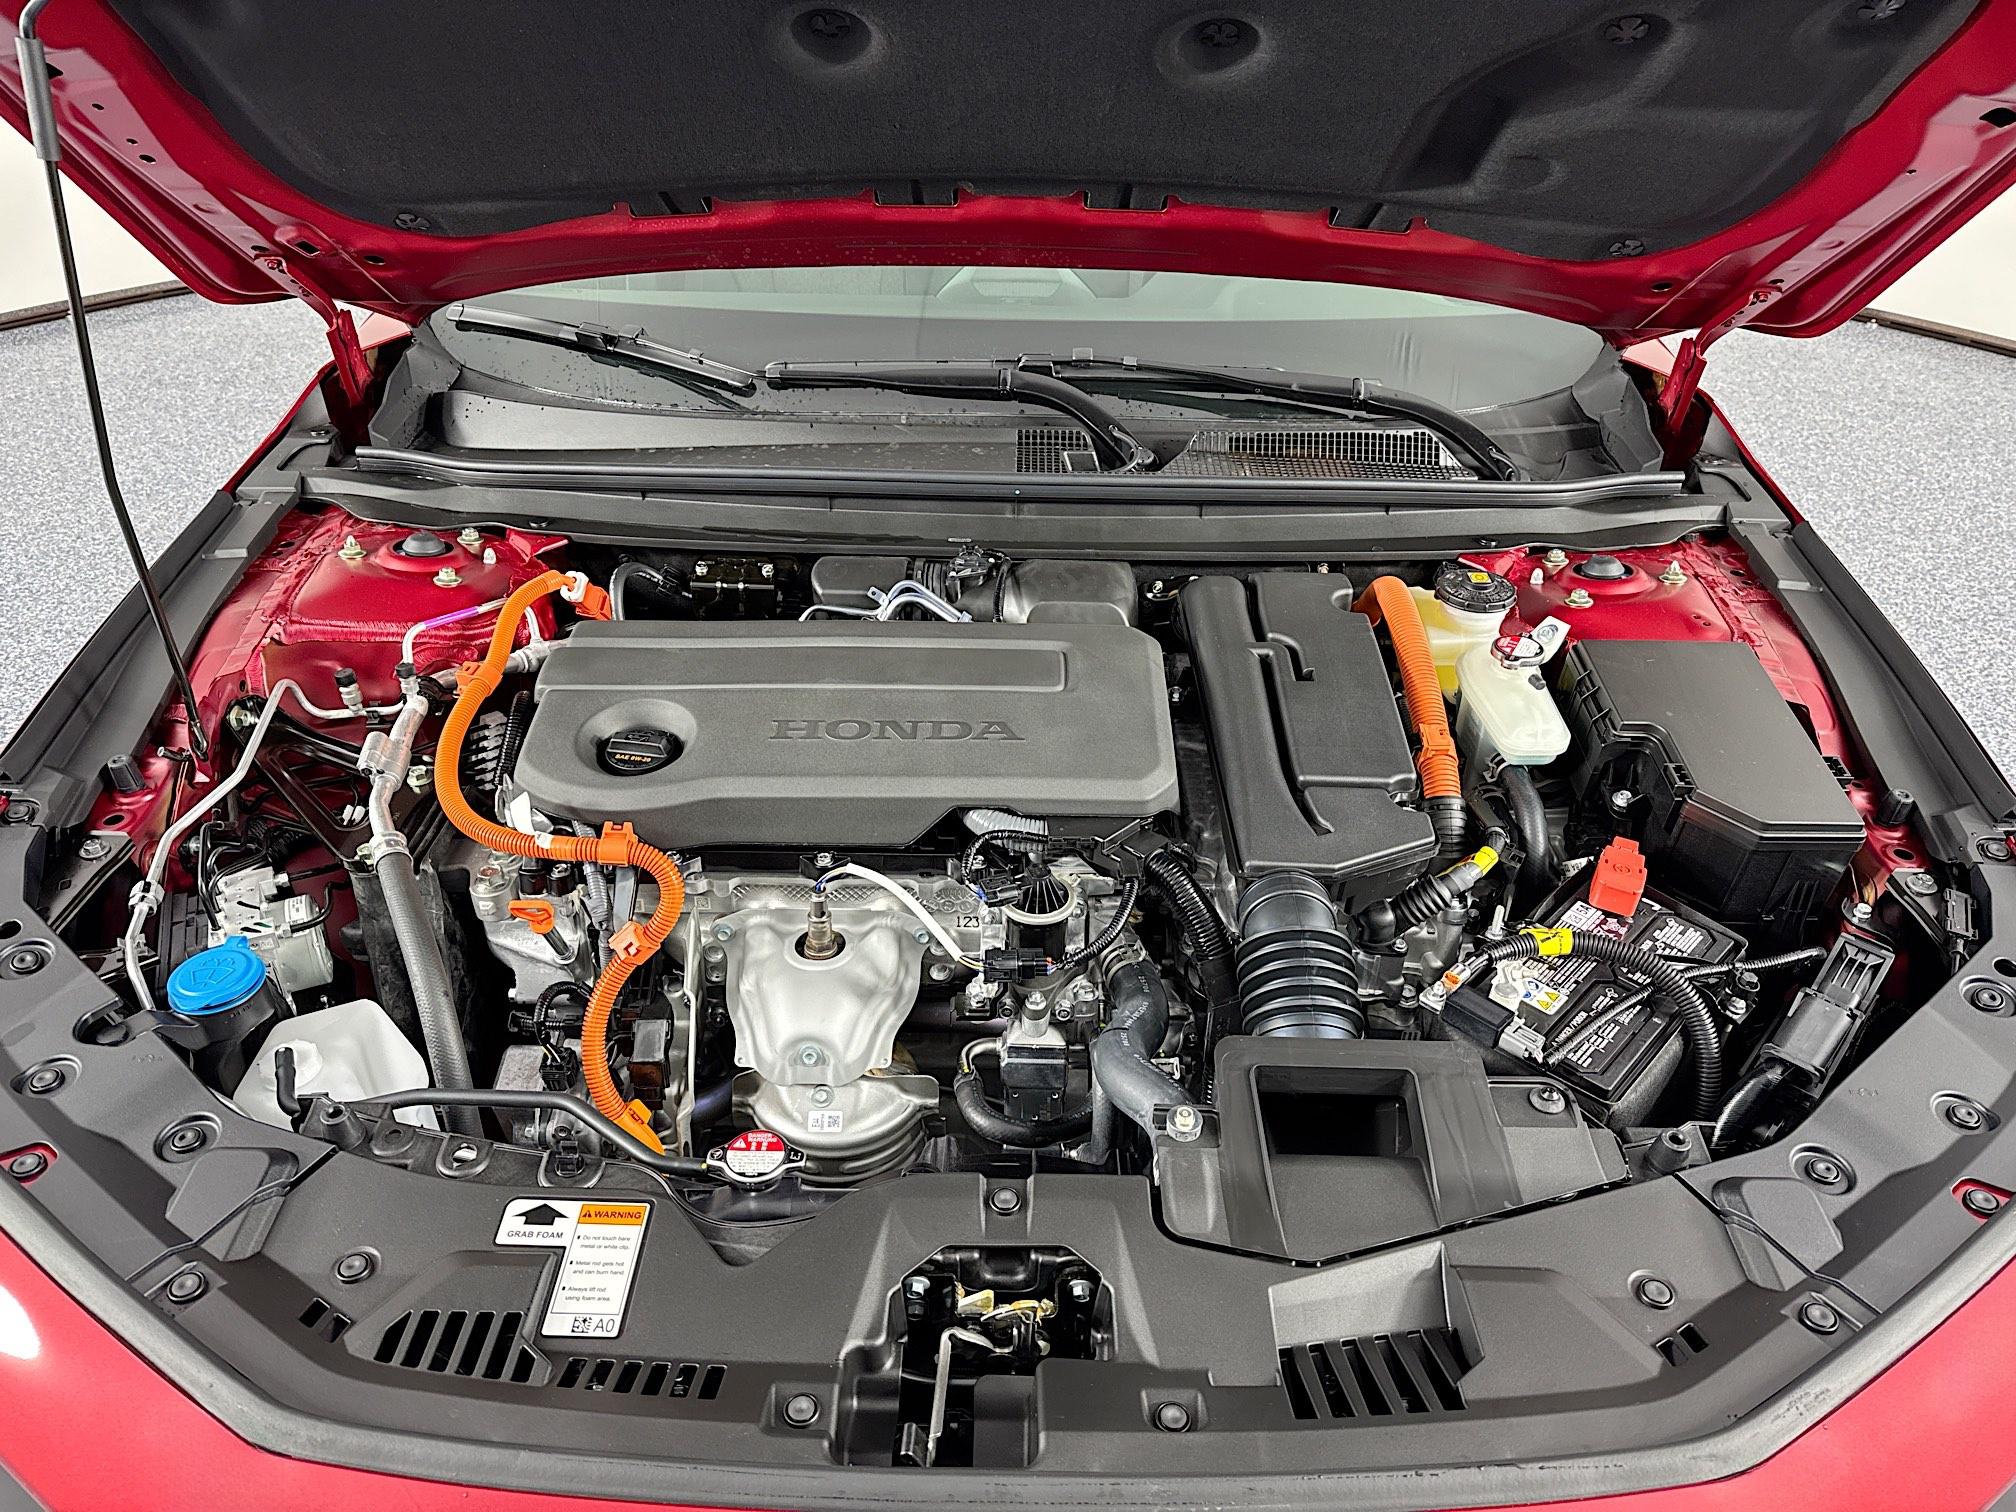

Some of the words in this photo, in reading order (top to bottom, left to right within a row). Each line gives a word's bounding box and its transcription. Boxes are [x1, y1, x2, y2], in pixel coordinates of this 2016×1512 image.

[768, 719, 1026, 741] HONDA
[956, 916, 980, 928] 123
[594, 1210, 641, 1219] WARNING
[507, 1230, 534, 1238] GRAB
[536, 1231, 564, 1239] FOAM
[593, 1318, 615, 1333] A0
